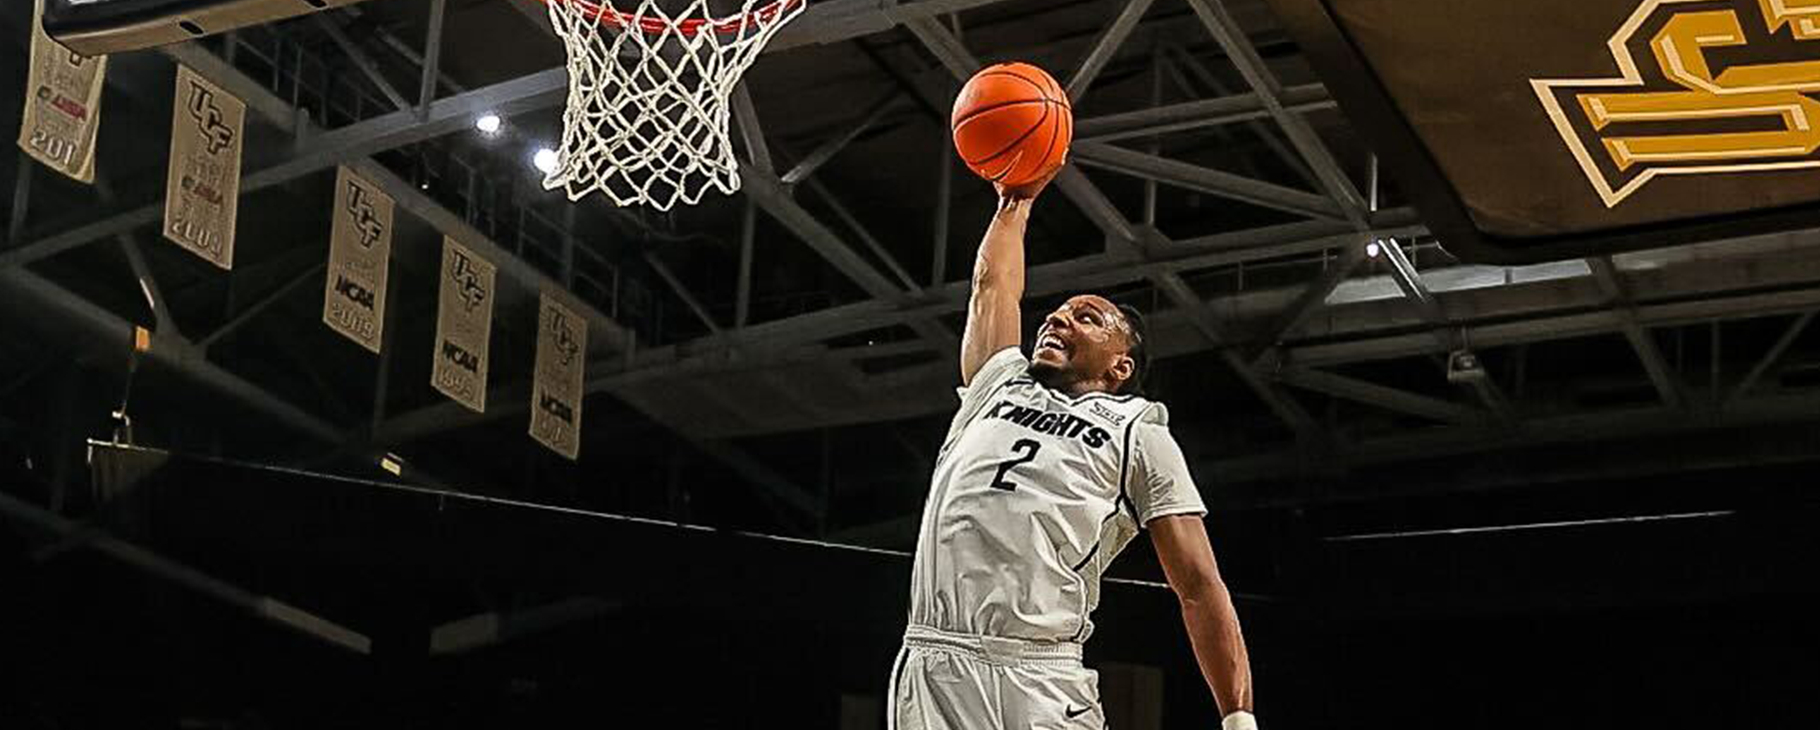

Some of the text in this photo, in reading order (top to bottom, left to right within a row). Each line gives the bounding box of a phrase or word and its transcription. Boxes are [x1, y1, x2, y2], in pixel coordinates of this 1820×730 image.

[188, 80, 233, 155] UCF
[346, 179, 383, 249] UCF
[335, 274, 374, 311] NCAA
[452, 249, 485, 313] UCF
[442, 340, 478, 373] NCAA
[984, 400, 1112, 449] KNIGHTS
[990, 438, 1041, 492] 2
